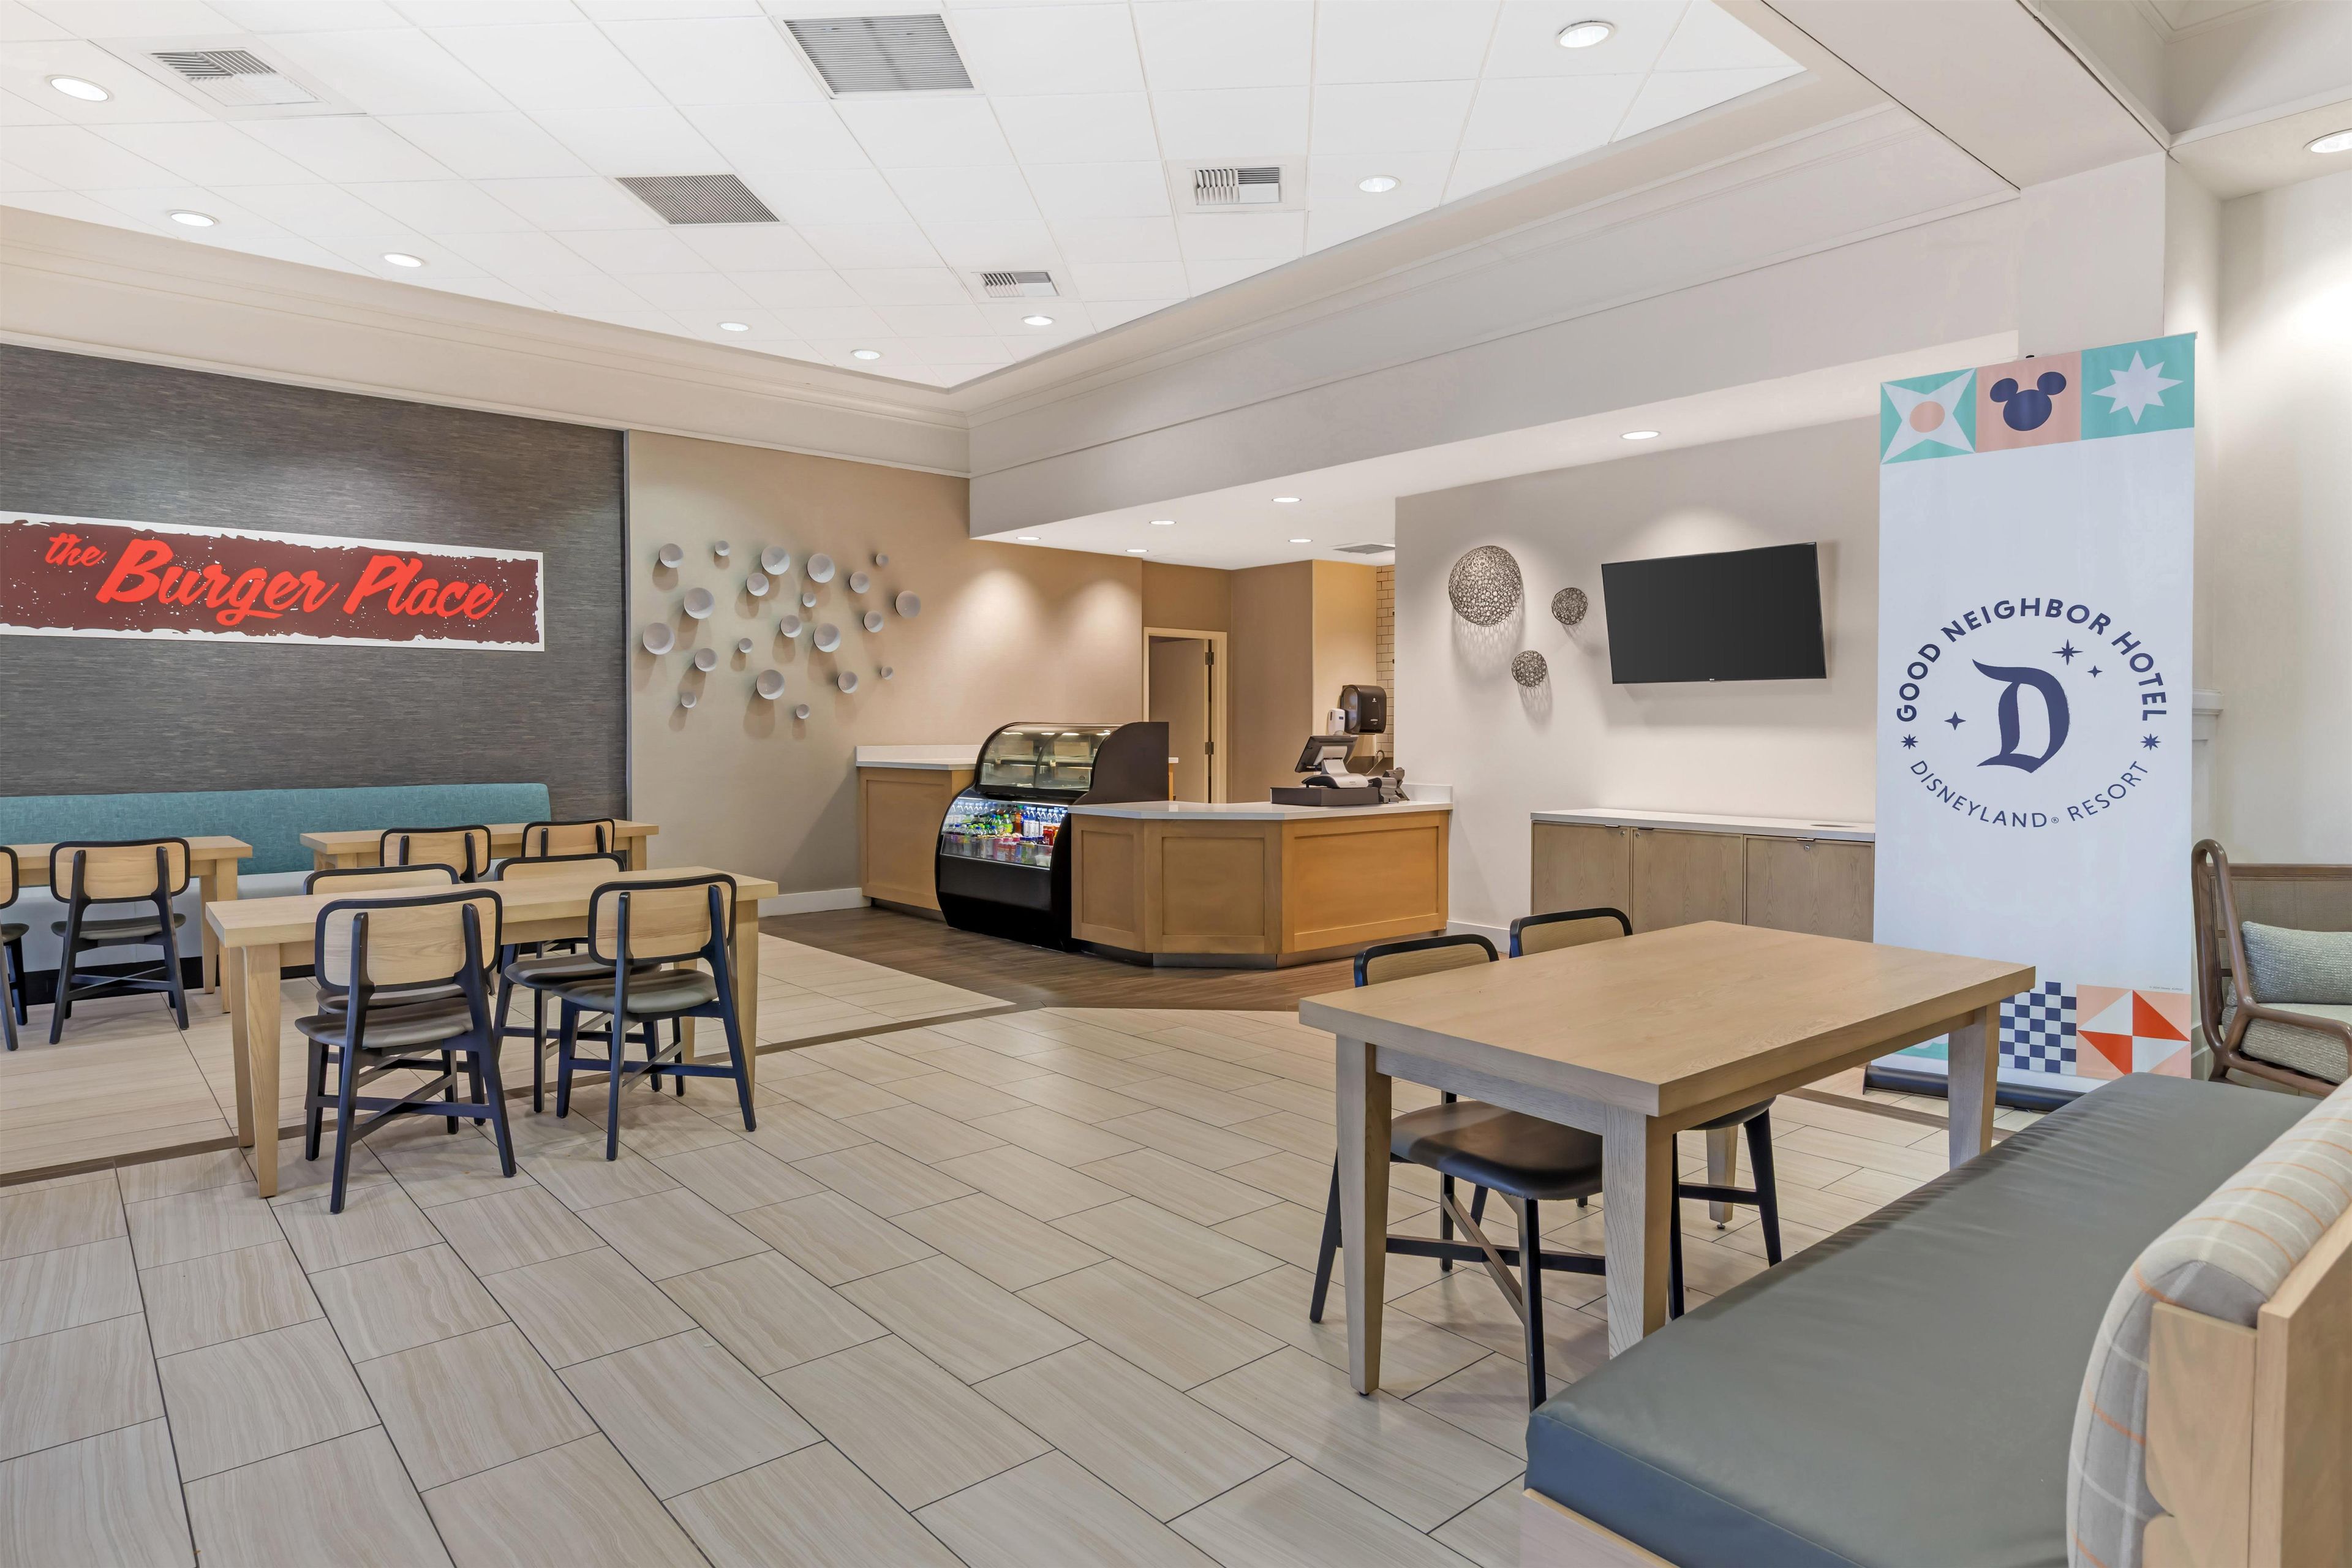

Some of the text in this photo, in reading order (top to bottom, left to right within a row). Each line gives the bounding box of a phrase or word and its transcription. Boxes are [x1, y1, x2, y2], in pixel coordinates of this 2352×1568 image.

[45, 532, 503, 626] the Burger Place
[1896, 597, 2167, 722] GOOD NEIGHBOR HOTEL
[2067, 761, 2148, 821] RESORT
